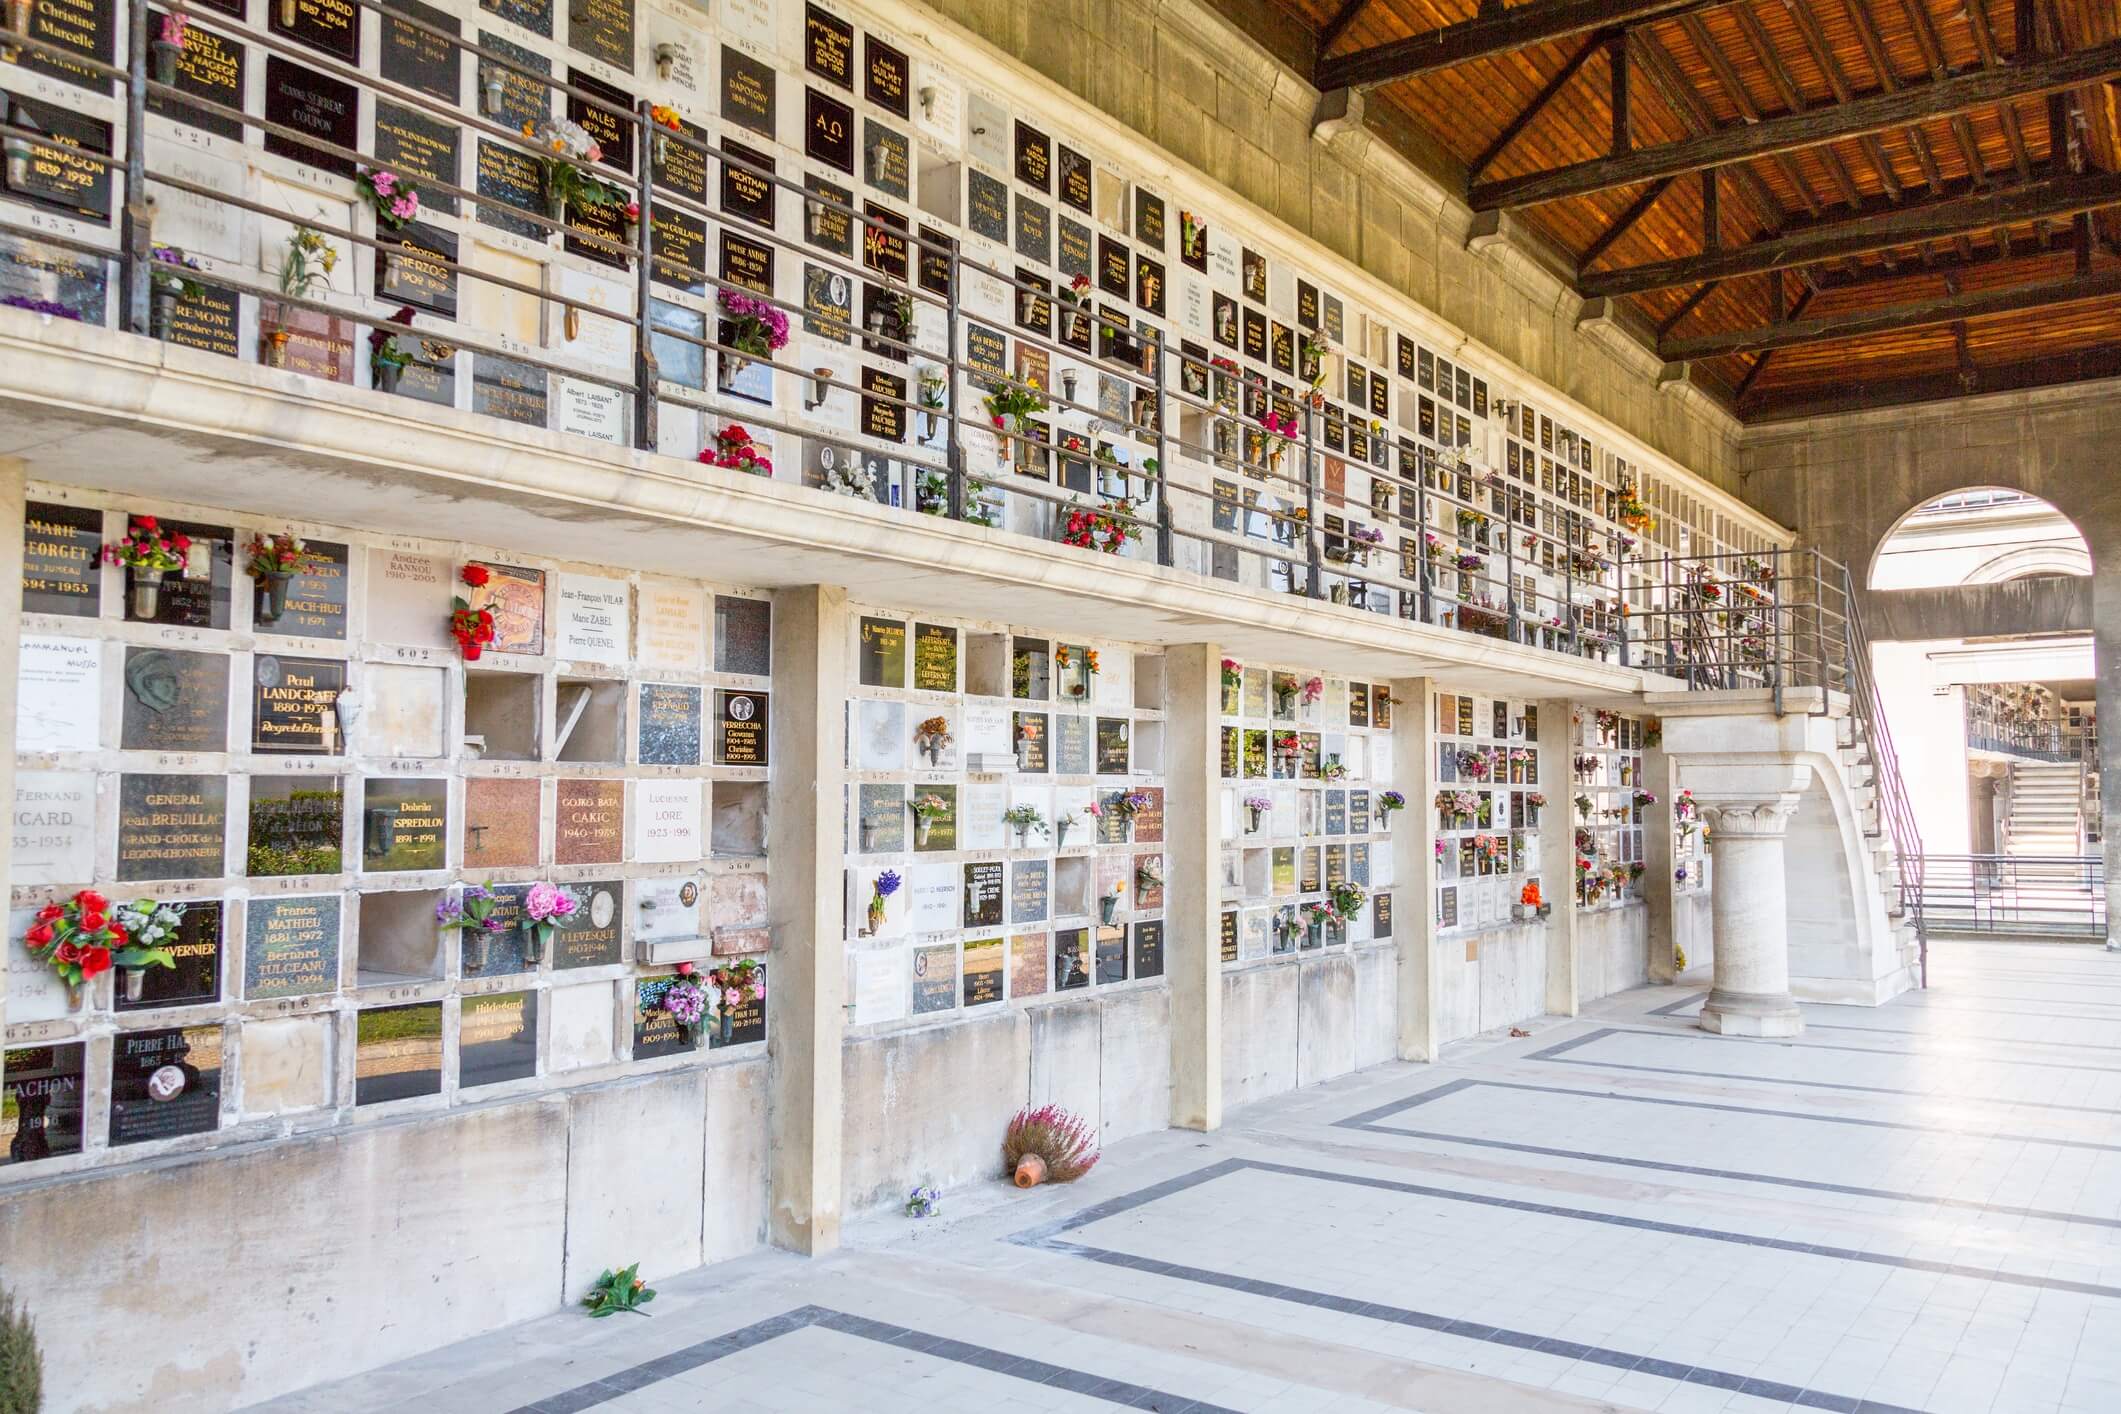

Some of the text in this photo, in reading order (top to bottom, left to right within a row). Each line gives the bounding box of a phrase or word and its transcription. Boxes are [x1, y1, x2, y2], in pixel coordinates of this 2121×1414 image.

[39, 1, 97, 32] Christine
[40, 18, 96, 49] Marcelle
[183, 27, 222, 49] NELLY
[176, 60, 237, 89] 921 1992
[292, 108, 332, 133] COUPON
[66, 168, 95, 188] 1923
[729, 169, 768, 192] HECHTMAN
[597, 226, 623, 244] CANO
[201, 295, 231, 312] Louis
[872, 413, 896, 428] FAUCHER
[588, 430, 613, 441] LAISANT
[29, 519, 78, 538] MARIE
[390, 562, 432, 575] RANNOU
[285, 600, 342, 614] MACH-HUU
[603, 593, 625, 606] VILAR
[572, 612, 613, 627] Marie ZABEL
[568, 634, 616, 649] Pierre QUENEL
[397, 648, 430, 659] 602
[287, 673, 314, 687] Paul
[263, 687, 337, 701] LANDGRAFF
[721, 720, 762, 731] VERRECCHIA
[16, 788, 81, 802] FERNAND
[268, 917, 320, 931] MATHIEU
[267, 949, 319, 962] Bernard
[278, 1000, 310, 1012] 616
[128, 1038, 164, 1055] PIERRE
